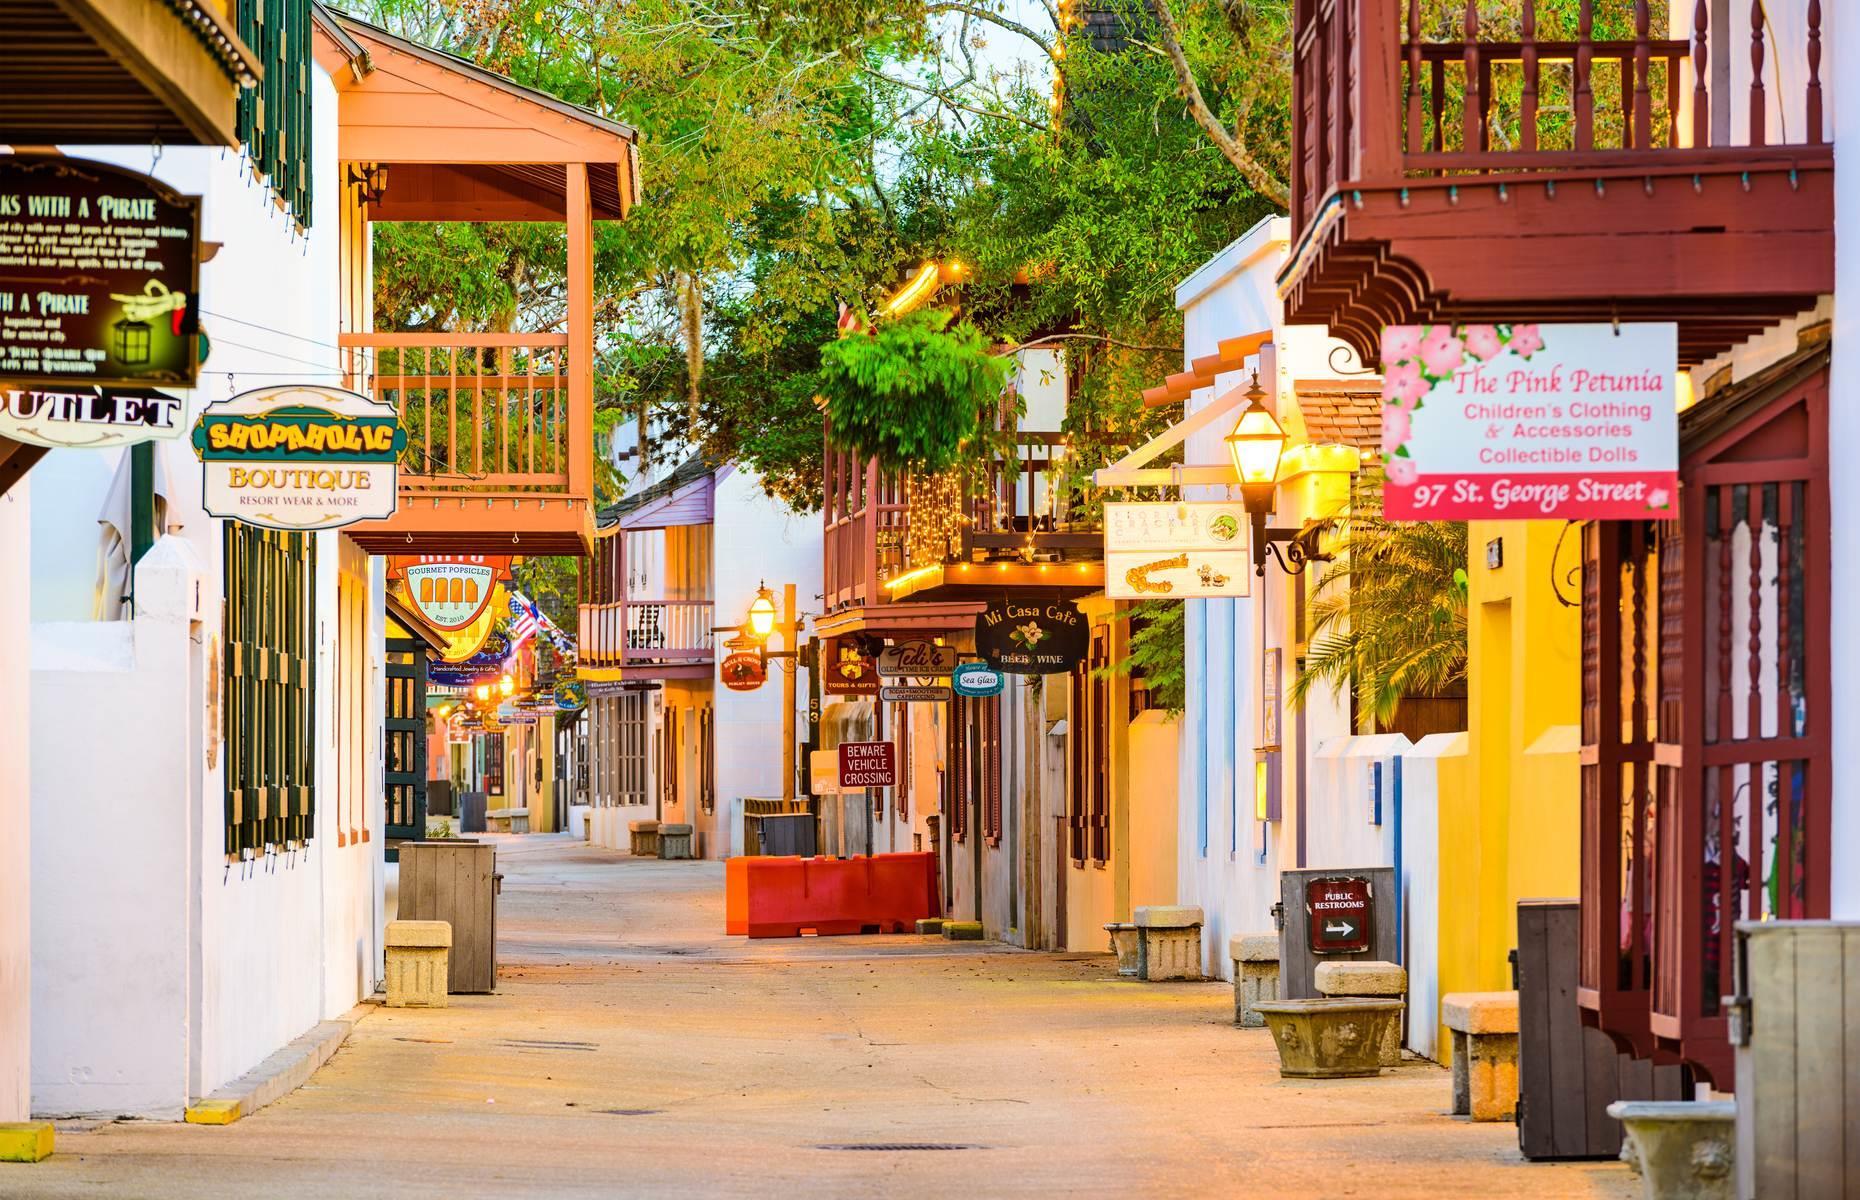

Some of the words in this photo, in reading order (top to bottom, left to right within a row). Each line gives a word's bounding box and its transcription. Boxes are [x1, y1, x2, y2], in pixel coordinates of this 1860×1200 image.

[0, 194, 21, 216] KS
[28, 195, 71, 218] WITH
[77, 196, 90, 218] A
[97, 195, 157, 223] PIRATE
[20, 293, 30, 312] A
[36, 291, 90, 317] PIRATE
[1453, 364, 1498, 395] The
[1505, 364, 1563, 394] Pink
[1569, 368, 1663, 394] Petunia
[0, 389, 181, 428] UTLET
[1464, 402, 1563, 420] Children's
[1569, 401, 1652, 421] Clothing
[208, 422, 394, 453] SHOPAHOLIC
[1484, 424, 1504, 439] &
[1513, 423, 1632, 438] Accessories
[1479, 447, 1582, 464] Collectible
[1588, 446, 1638, 463] Dolls
[228, 467, 371, 491] BOUTIQUE
[239, 496, 280, 506] RESORT
[283, 496, 313, 506] WEAR
[316, 497, 324, 506] &
[327, 497, 358, 506] MORE
[1413, 484, 1448, 509] 97
[1451, 479, 1484, 504] St.
[1490, 479, 1569, 514] George
[1575, 478, 1648, 502] Street
[408, 566, 447, 576] GOURMET
[449, 566, 490, 577] POPSICLES
[435, 615, 449, 623] EST.
[984, 609, 1003, 627] Mi
[1006, 605, 1040, 619] Casa
[1046, 605, 1077, 627] Cafe
[888, 643, 944, 670] Tedi's
[1001, 655, 1029, 664] BEER
[1037, 655, 1063, 664] WINE
[901, 665, 918, 673] TYME
[919, 665, 929, 673] ICE
[962, 676, 975, 684] Sea
[977, 675, 996, 686] Glass
[847, 745, 886, 758] BEWARE
[847, 758, 888, 771] VEHICLE
[844, 771, 892, 785] CROSSING
[1325, 892, 1354, 901] PUBLIC
[1314, 901, 1365, 910] RESTROOMS
